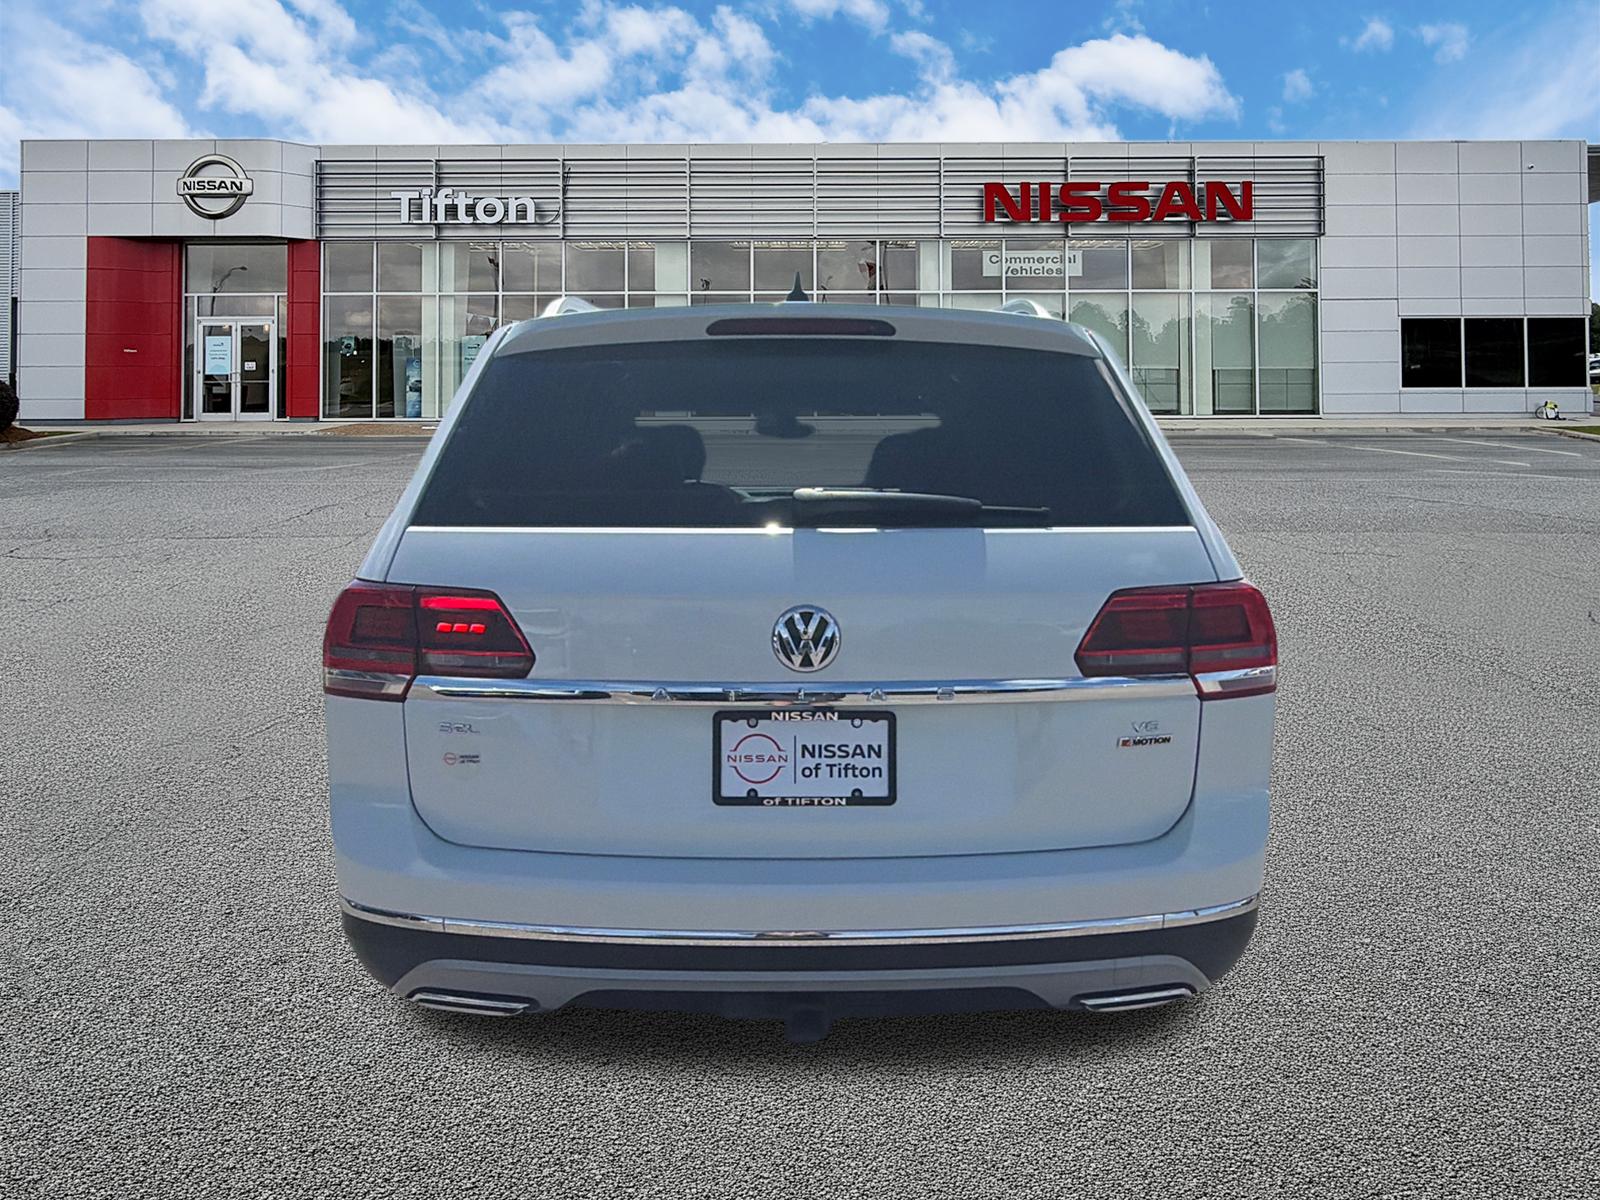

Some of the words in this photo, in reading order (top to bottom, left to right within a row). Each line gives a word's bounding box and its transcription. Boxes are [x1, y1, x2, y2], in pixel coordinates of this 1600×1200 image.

[182, 181, 244, 192] NISSAN
[391, 188, 536, 224] Tifton
[983, 181, 1253, 222] NISSAN
[771, 711, 839, 722] NISSAN
[800, 744, 883, 759] NISSAN
[727, 754, 789, 763] NISSAN
[800, 763, 822, 778] of
[826, 763, 883, 778] Tifton
[762, 797, 782, 806] of
[788, 797, 847, 806] TIFTON
